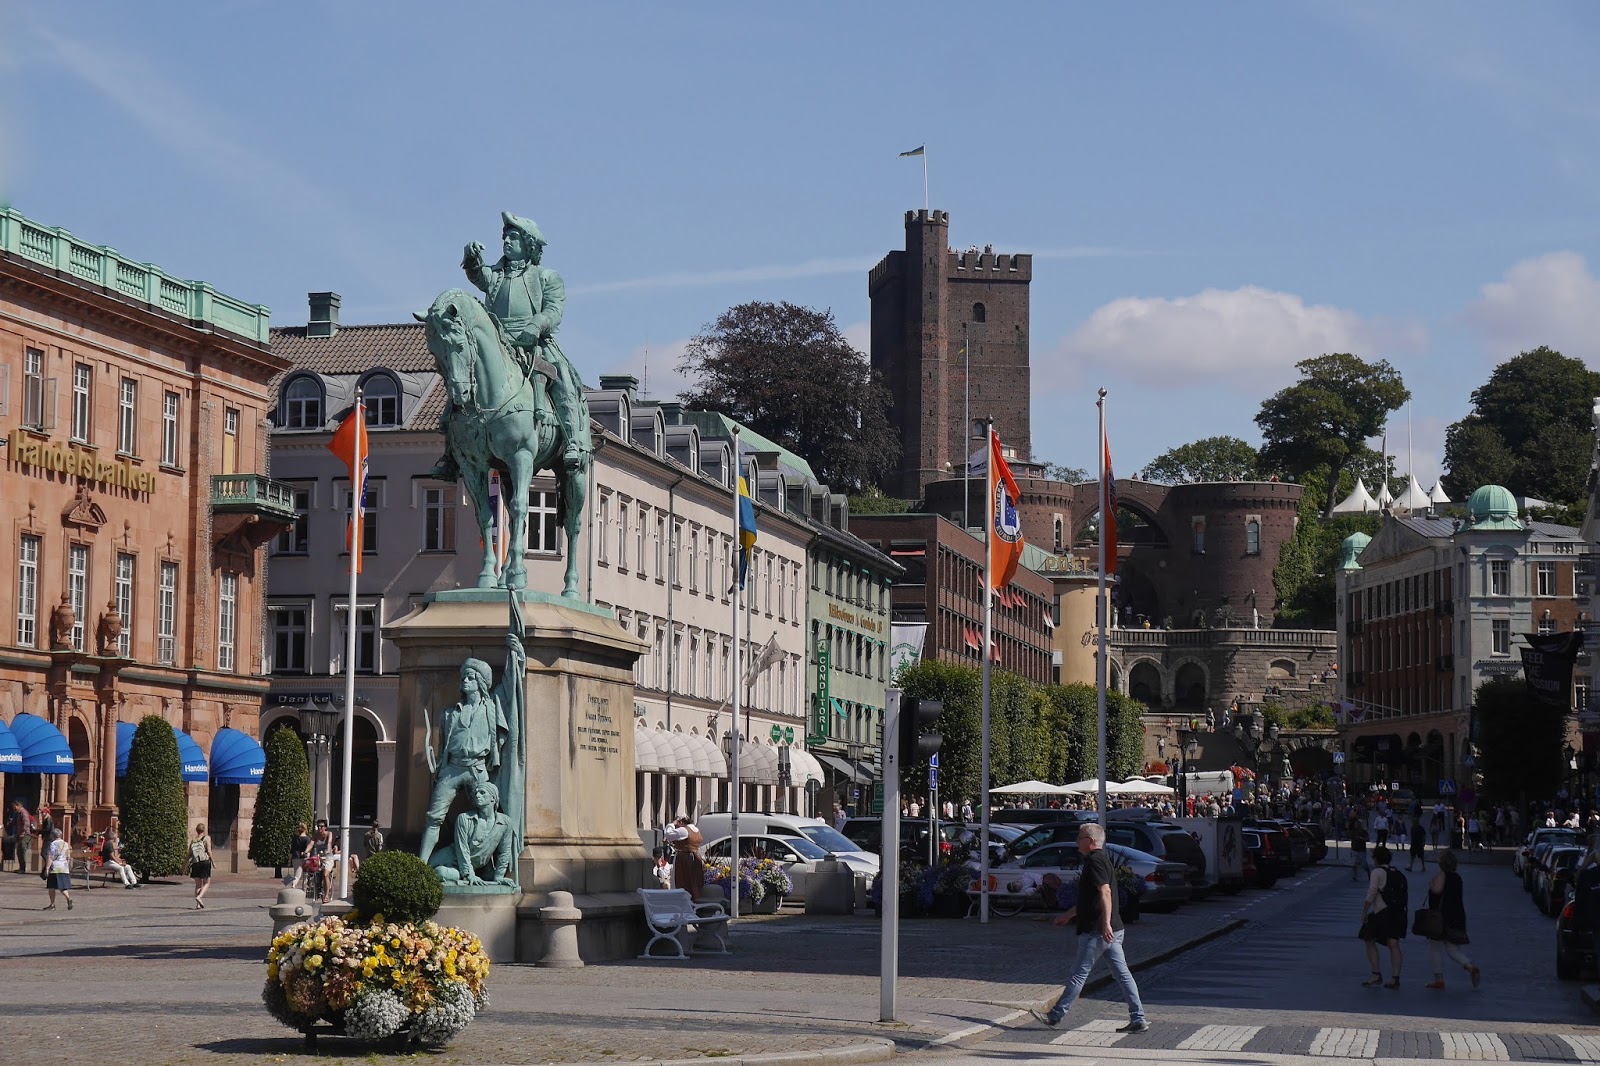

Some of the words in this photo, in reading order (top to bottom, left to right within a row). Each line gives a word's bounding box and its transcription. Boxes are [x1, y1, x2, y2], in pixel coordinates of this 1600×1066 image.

[9, 428, 157, 494] Handelsbanken
[1046, 556, 1090, 571] POST
[1523, 652, 1545, 664] FEEL
[335, 695, 370, 703] Bnk
